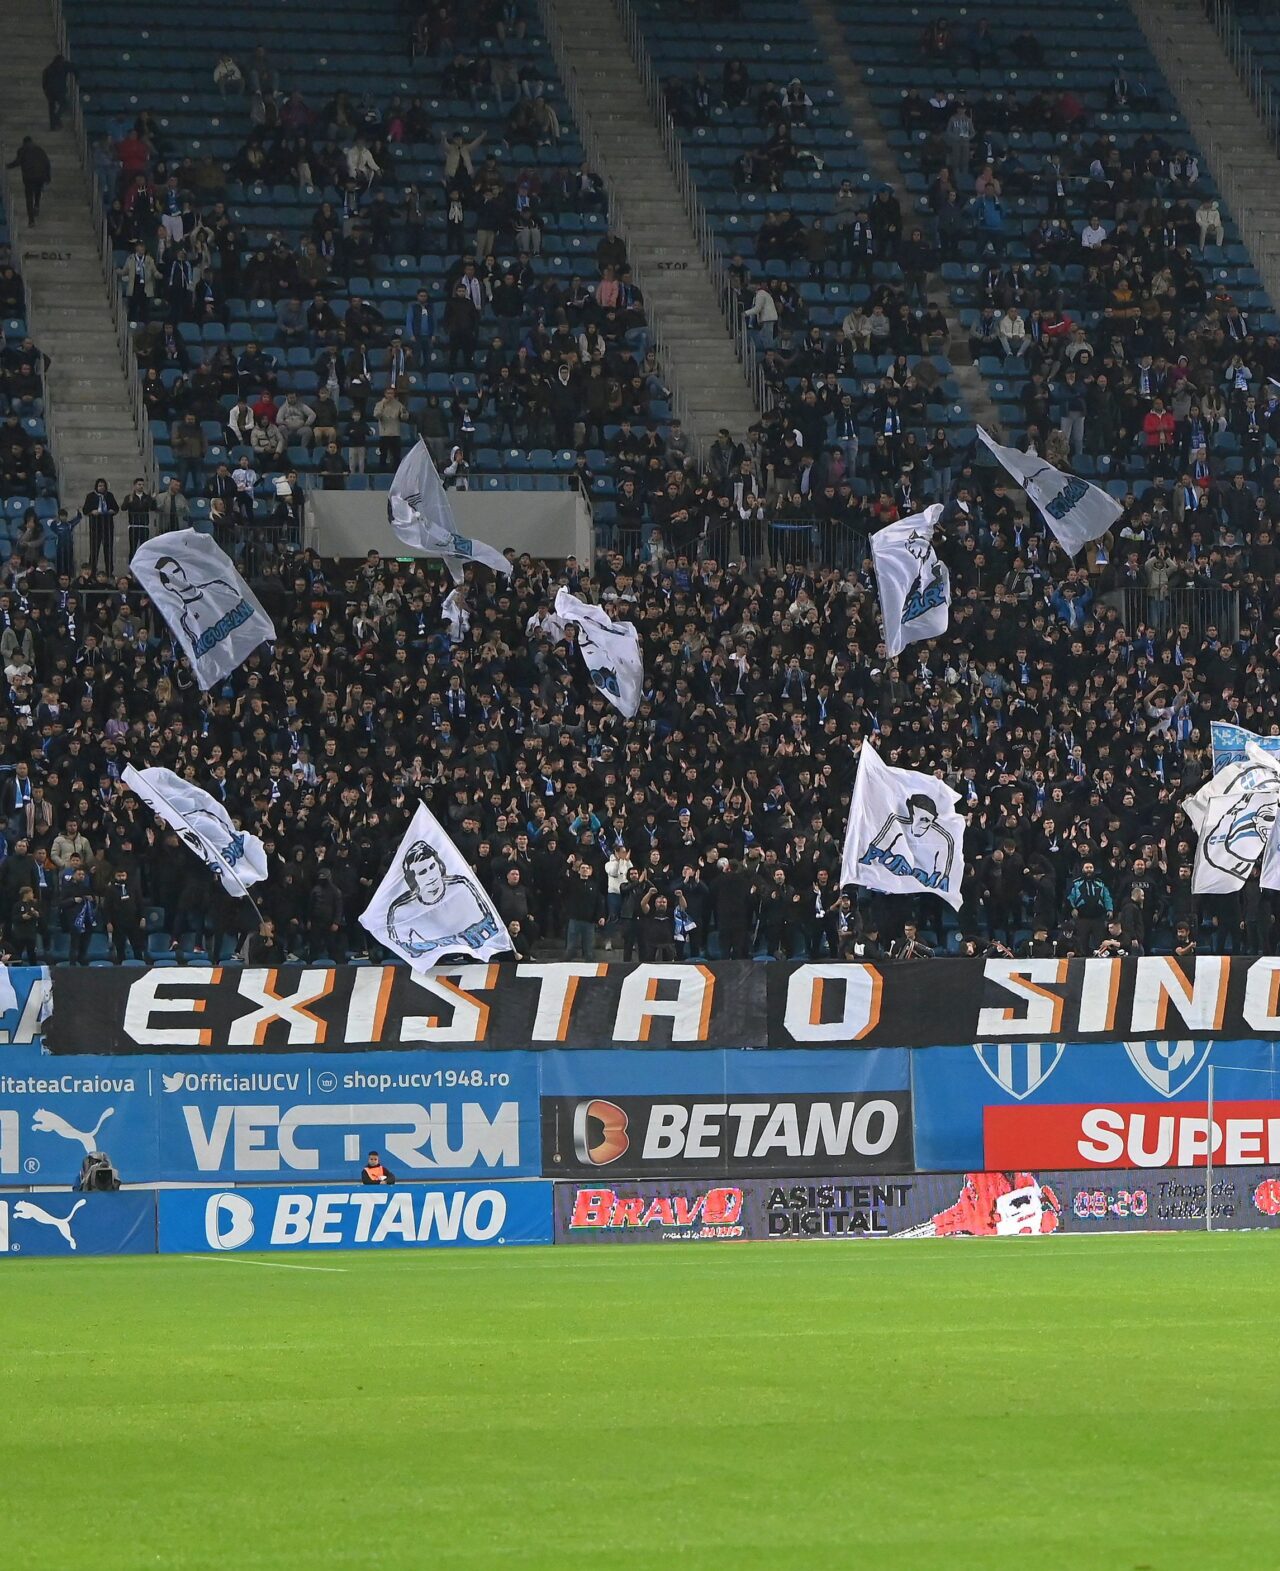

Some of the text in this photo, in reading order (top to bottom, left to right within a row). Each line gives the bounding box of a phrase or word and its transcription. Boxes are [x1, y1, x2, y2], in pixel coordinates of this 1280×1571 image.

[123, 962, 717, 1047] EXISTA
[783, 963, 883, 1042] O
[185, 1072, 300, 1093] OfficialUCV
[343, 1068, 510, 1090] shop.ucv1948.ro
[183, 1101, 520, 1172] VECTRUM
[642, 1099, 899, 1160] BETANO
[270, 1189, 507, 1245] BETANO
[766, 1184, 912, 1210] ASISTENT
[768, 1211, 888, 1236] DIGITAL
